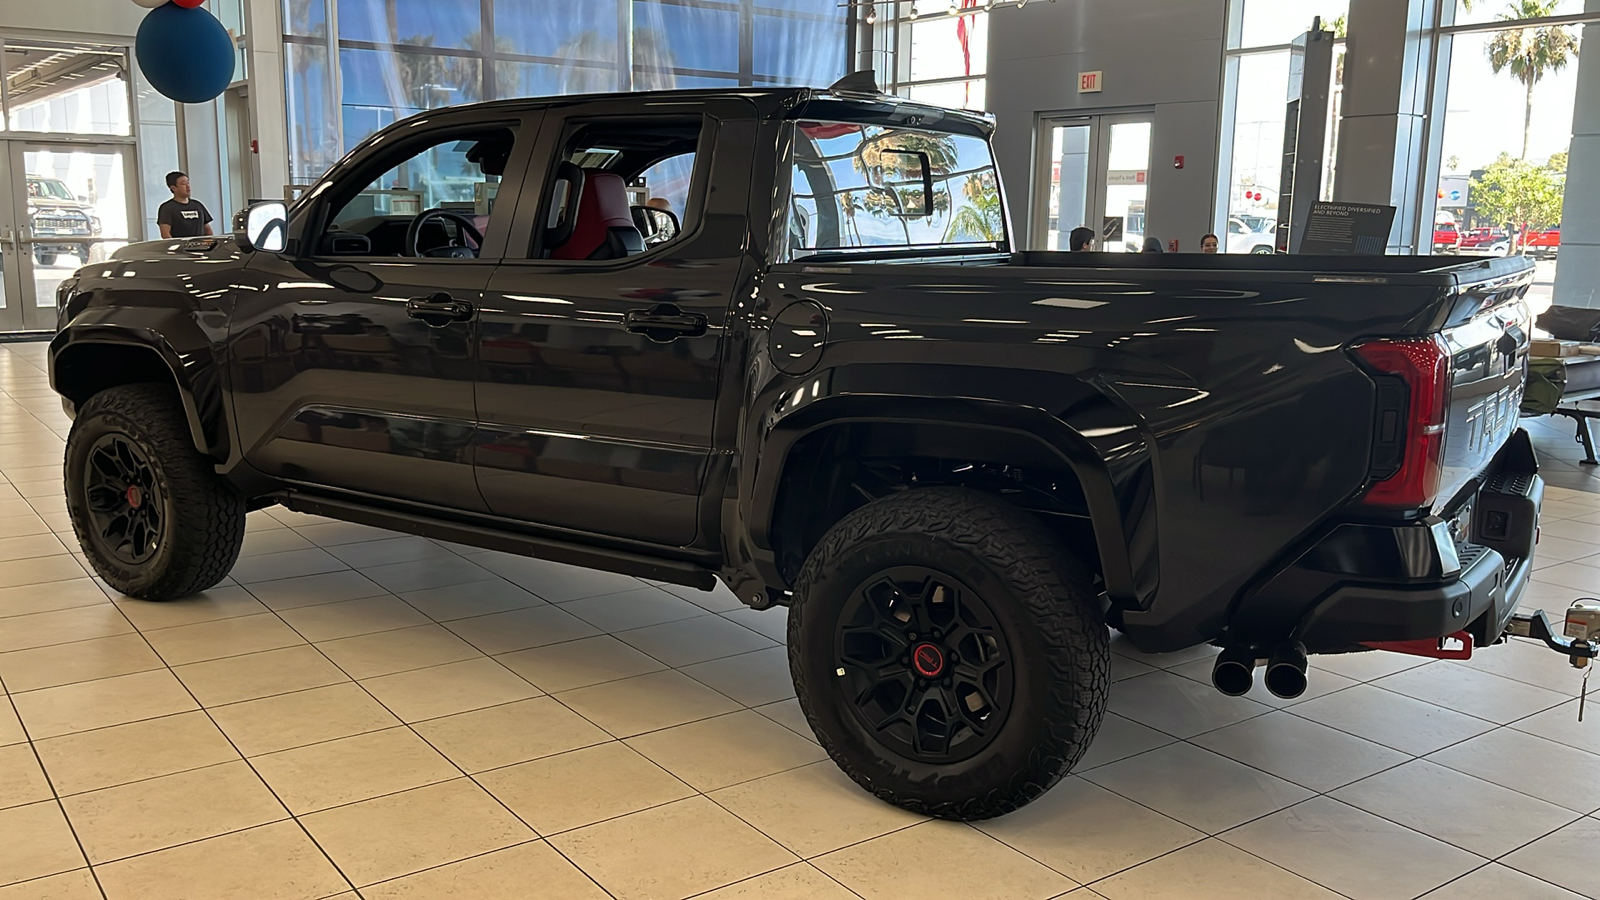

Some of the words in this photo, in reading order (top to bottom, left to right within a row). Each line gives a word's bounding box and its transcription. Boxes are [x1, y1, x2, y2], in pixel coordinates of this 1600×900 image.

[1082, 74, 1097, 90] EXIT
[1314, 204, 1347, 212] ELECTRIFIED
[1347, 206, 1381, 214] DIVERSIFIED
